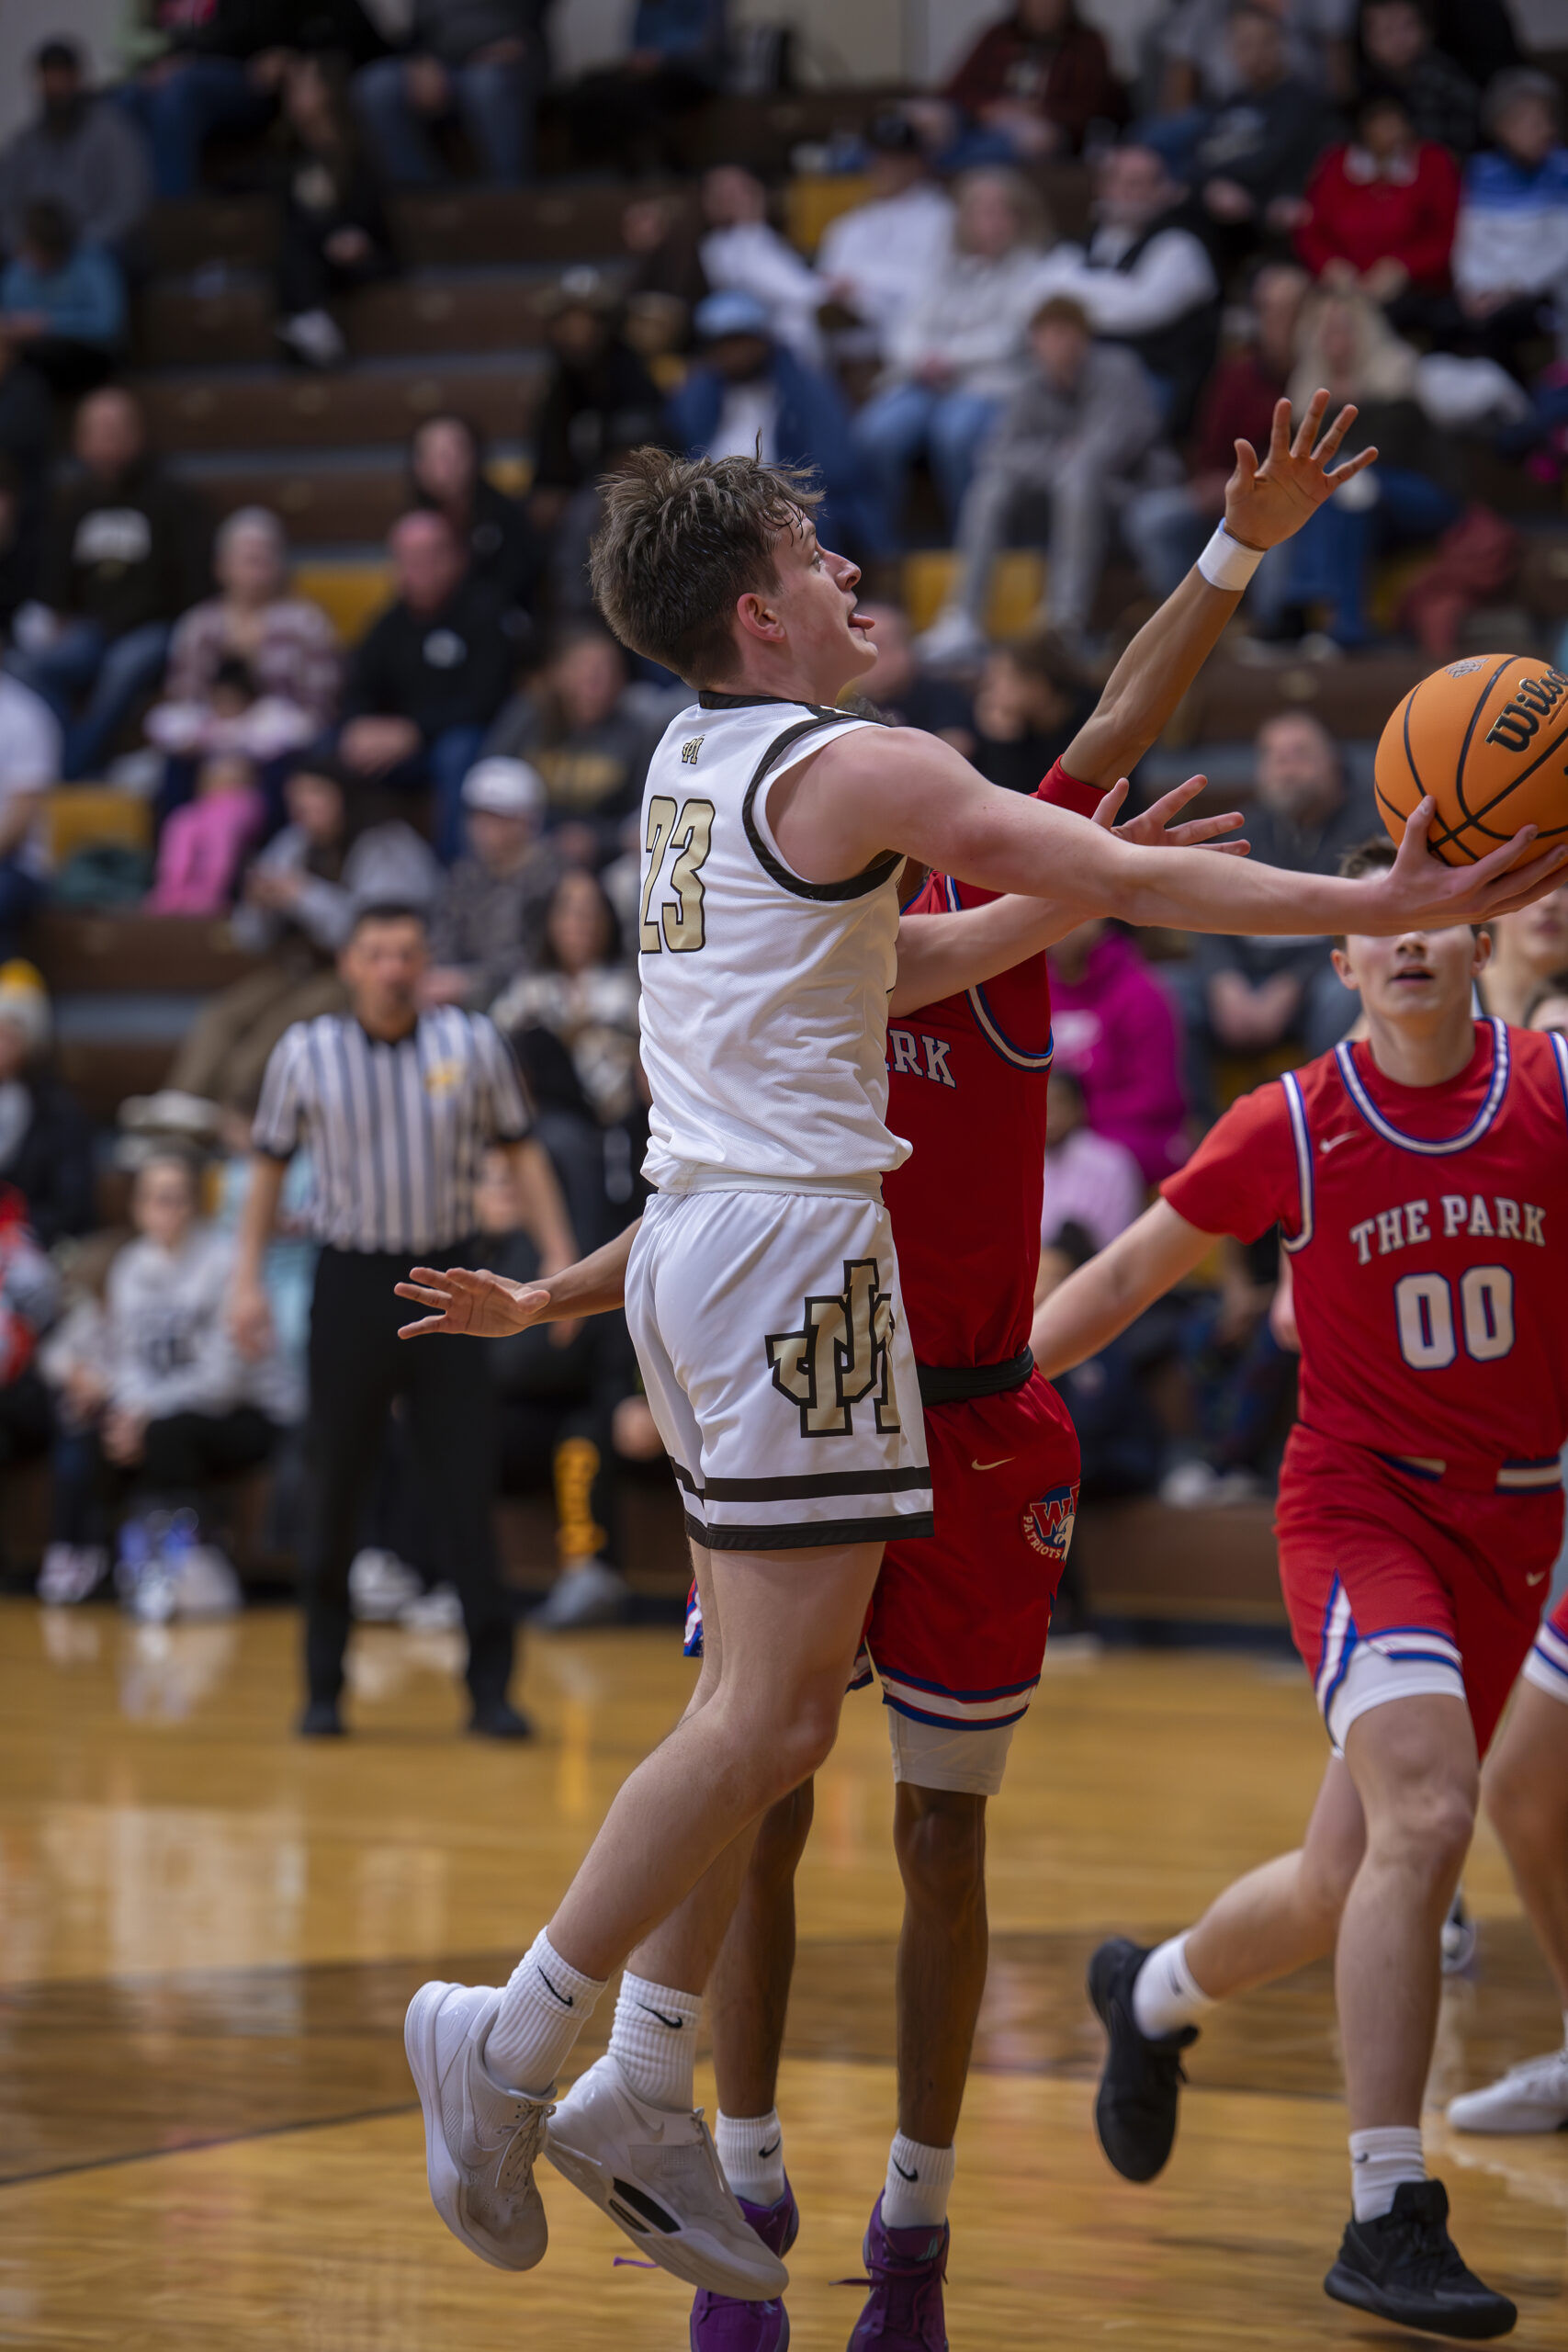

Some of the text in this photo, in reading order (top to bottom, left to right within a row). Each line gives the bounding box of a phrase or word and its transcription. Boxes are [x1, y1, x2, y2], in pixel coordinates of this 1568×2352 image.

[640, 796, 716, 954] 23
[885, 1028, 956, 1089] RK
[1348, 1194, 1547, 1266] THE PARK
[1393, 1263, 1516, 1371] 00
[1022, 1515, 1062, 1559] PATRIOTS
